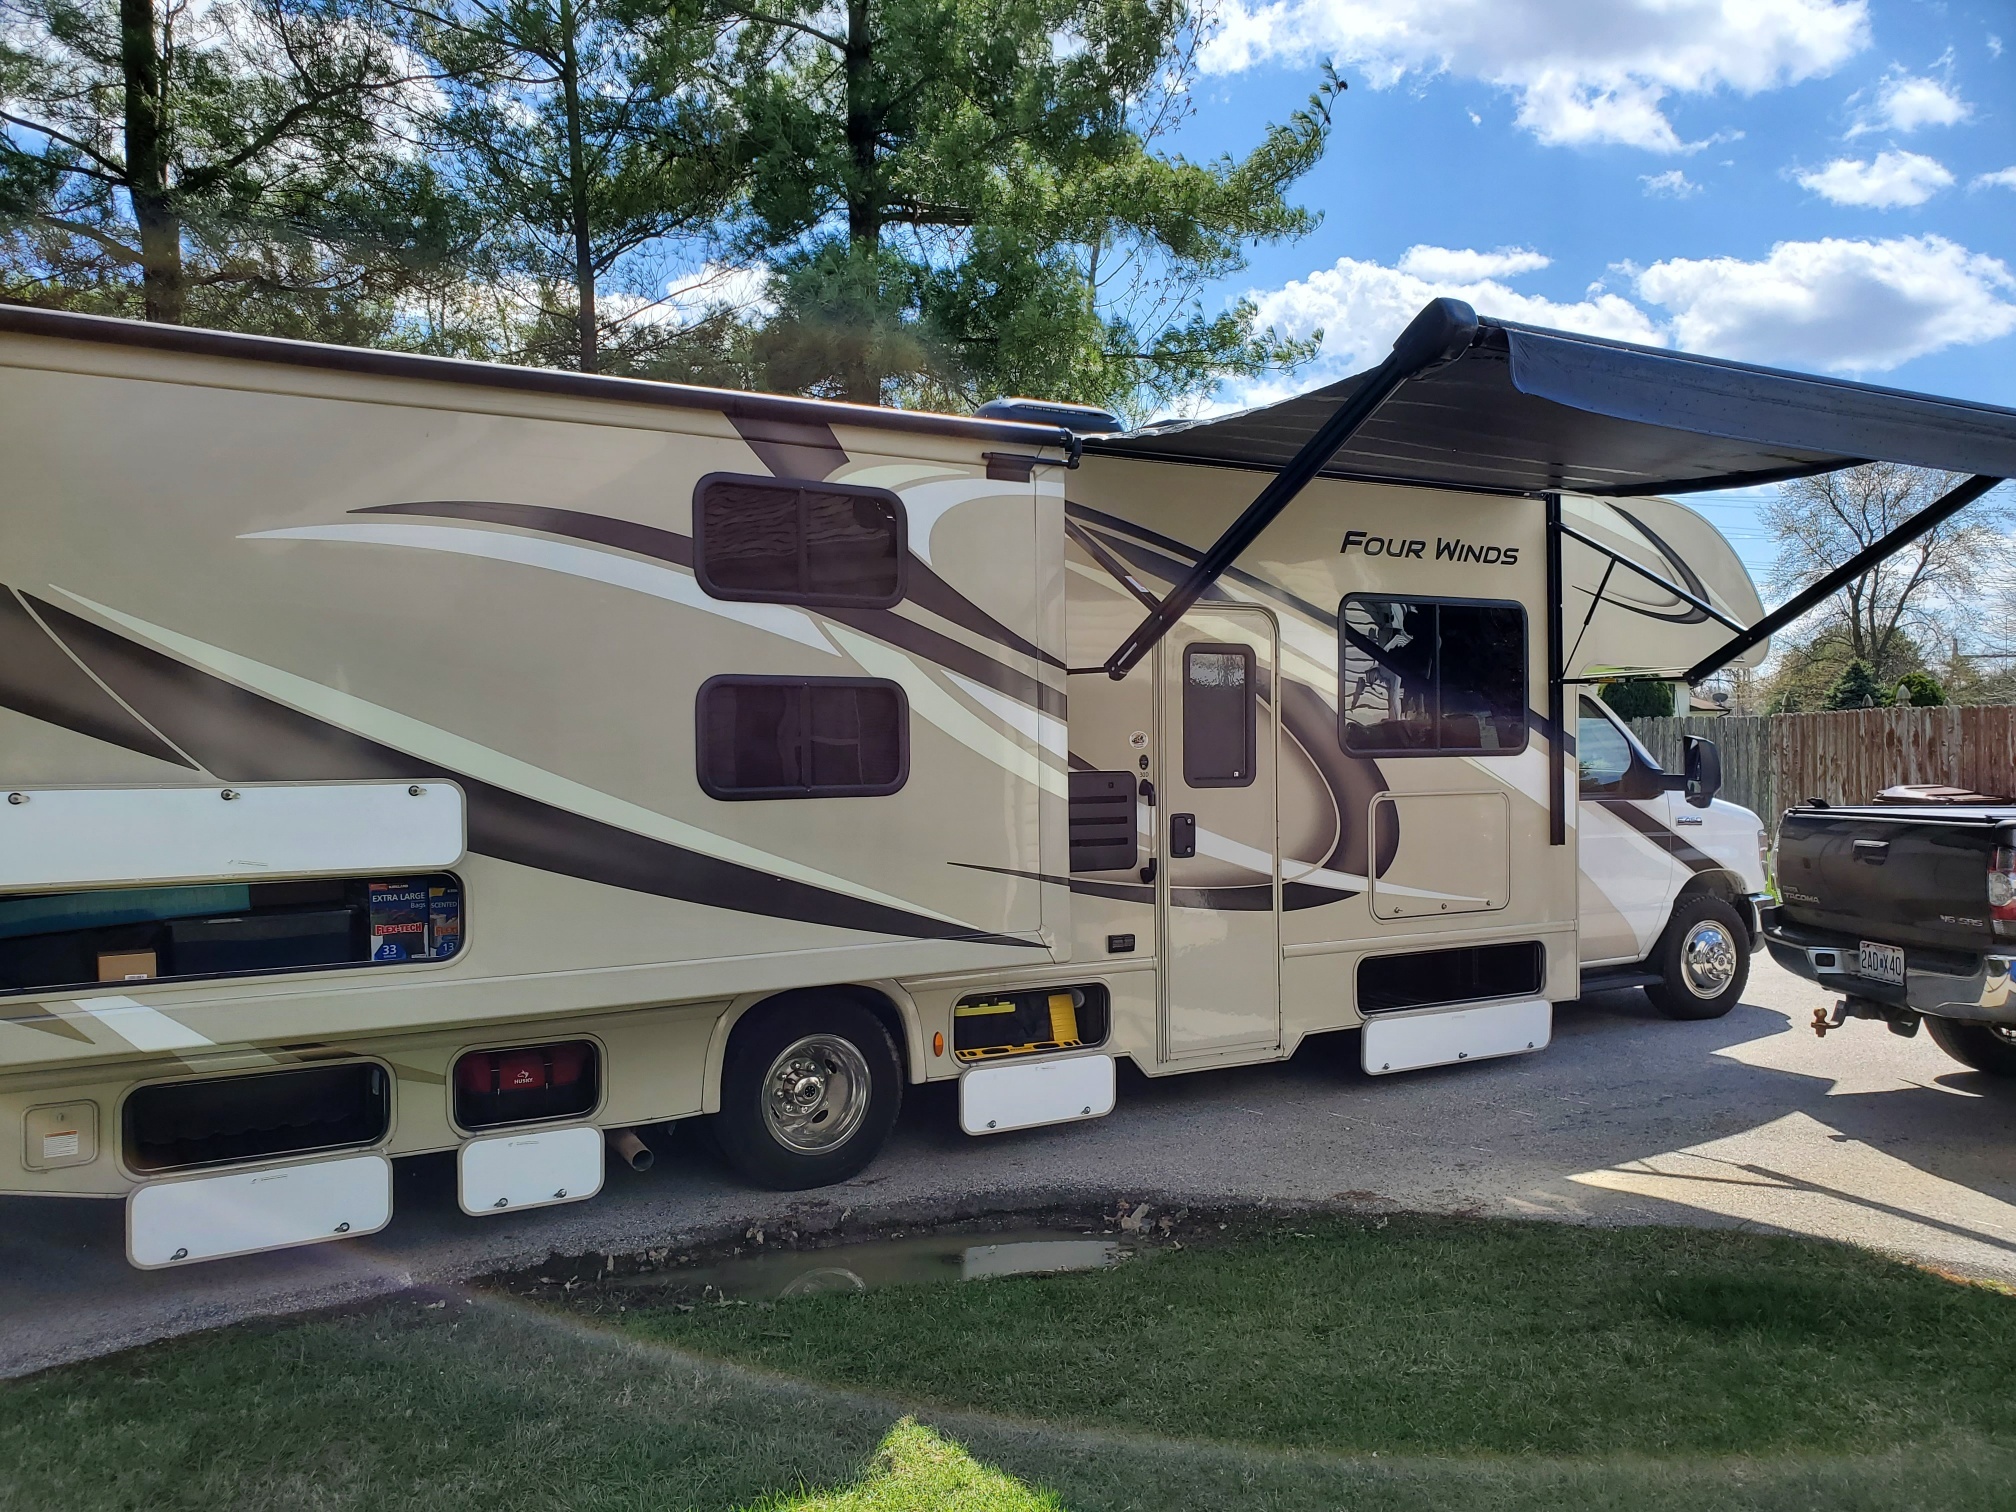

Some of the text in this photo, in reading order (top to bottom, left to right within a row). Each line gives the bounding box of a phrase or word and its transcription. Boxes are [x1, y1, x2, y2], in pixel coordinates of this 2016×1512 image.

[372, 892, 426, 902] EXTRA LARGE
[1783, 892, 1820, 904] TACOMA
[375, 922, 423, 936] FLEX-TECH
[382, 944, 397, 955] 33
[442, 942, 455, 952] 13
[1861, 949, 1902, 976] 2AD X40
